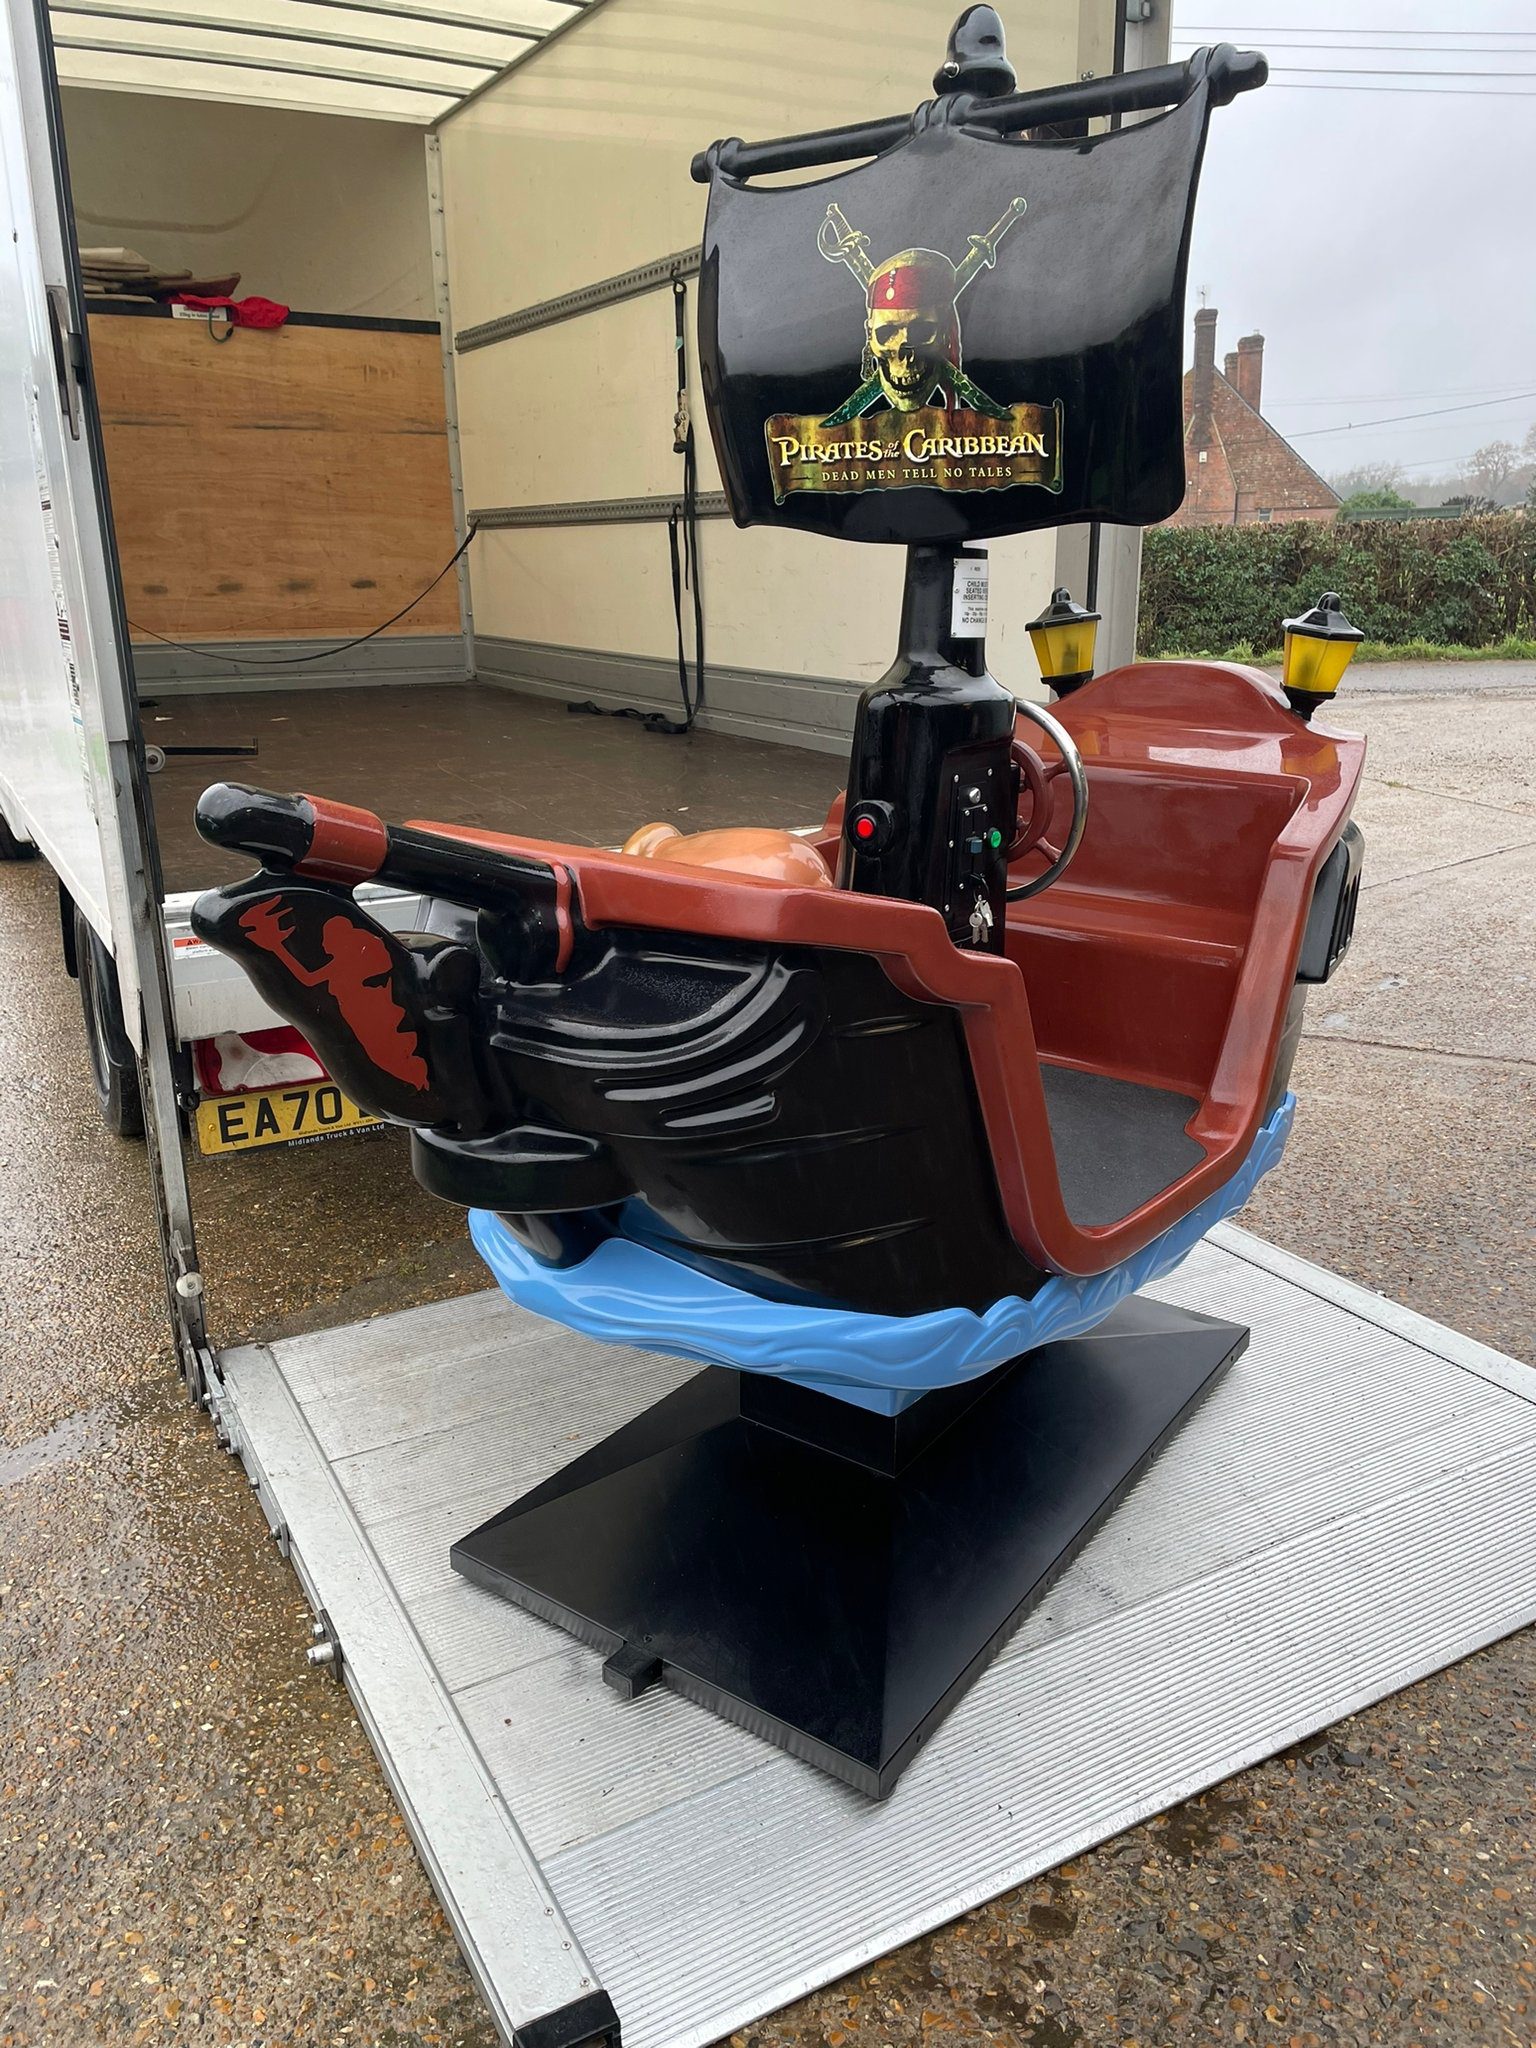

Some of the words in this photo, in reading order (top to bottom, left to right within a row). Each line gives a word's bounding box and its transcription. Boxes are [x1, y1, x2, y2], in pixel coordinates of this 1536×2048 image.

[771, 436, 884, 466] PIRATES
[884, 449, 900, 458] the
[888, 440, 899, 450] of
[902, 428, 1050, 463] CARIBBEAN
[822, 470, 859, 482] DEAD
[866, 469, 897, 480] MEN
[902, 468, 938, 479] TELL
[943, 467, 963, 478] NO
[969, 466, 1013, 478] TALES
[217, 1086, 343, 1144] EA70
[288, 1136, 324, 1146] Midlands
[326, 1130, 348, 1140] Truck
[372, 1123, 385, 1131] Ltd
